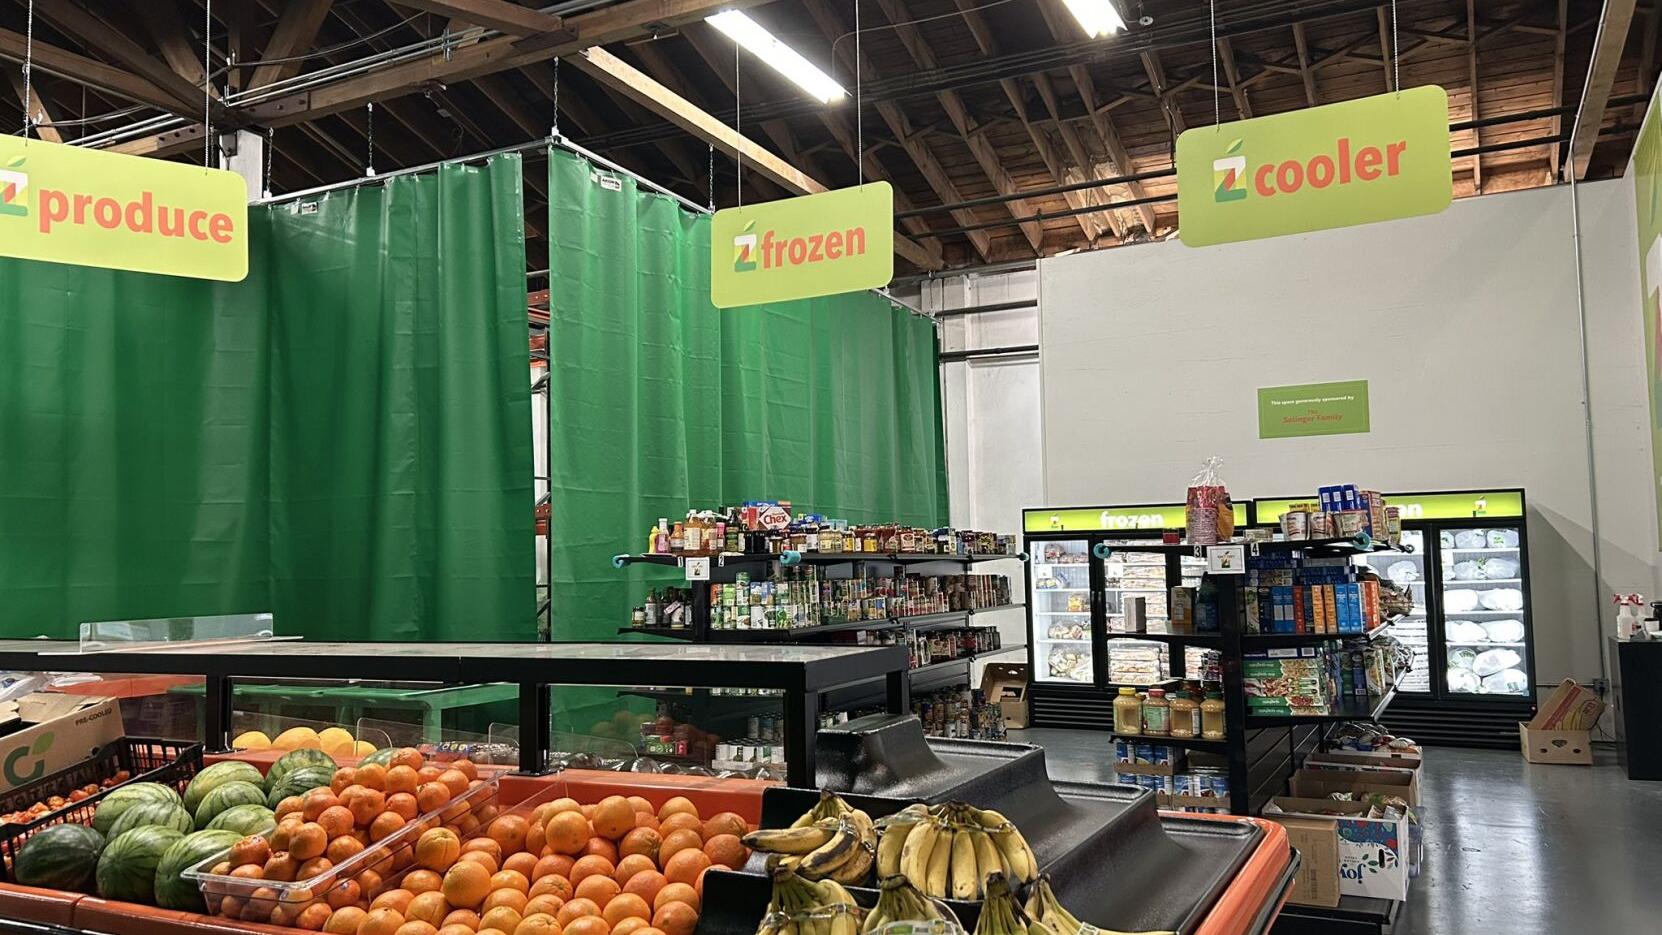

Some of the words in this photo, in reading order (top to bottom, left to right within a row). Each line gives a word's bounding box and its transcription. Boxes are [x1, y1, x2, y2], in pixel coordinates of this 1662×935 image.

[1255, 138, 1407, 197] cooler
[39, 189, 234, 244] produce
[761, 226, 865, 269] frozen
[763, 514, 787, 524] Chex
[1100, 510, 1164, 529] frozen
[1194, 545, 1201, 558] 3
[1252, 543, 1258, 556] 4
